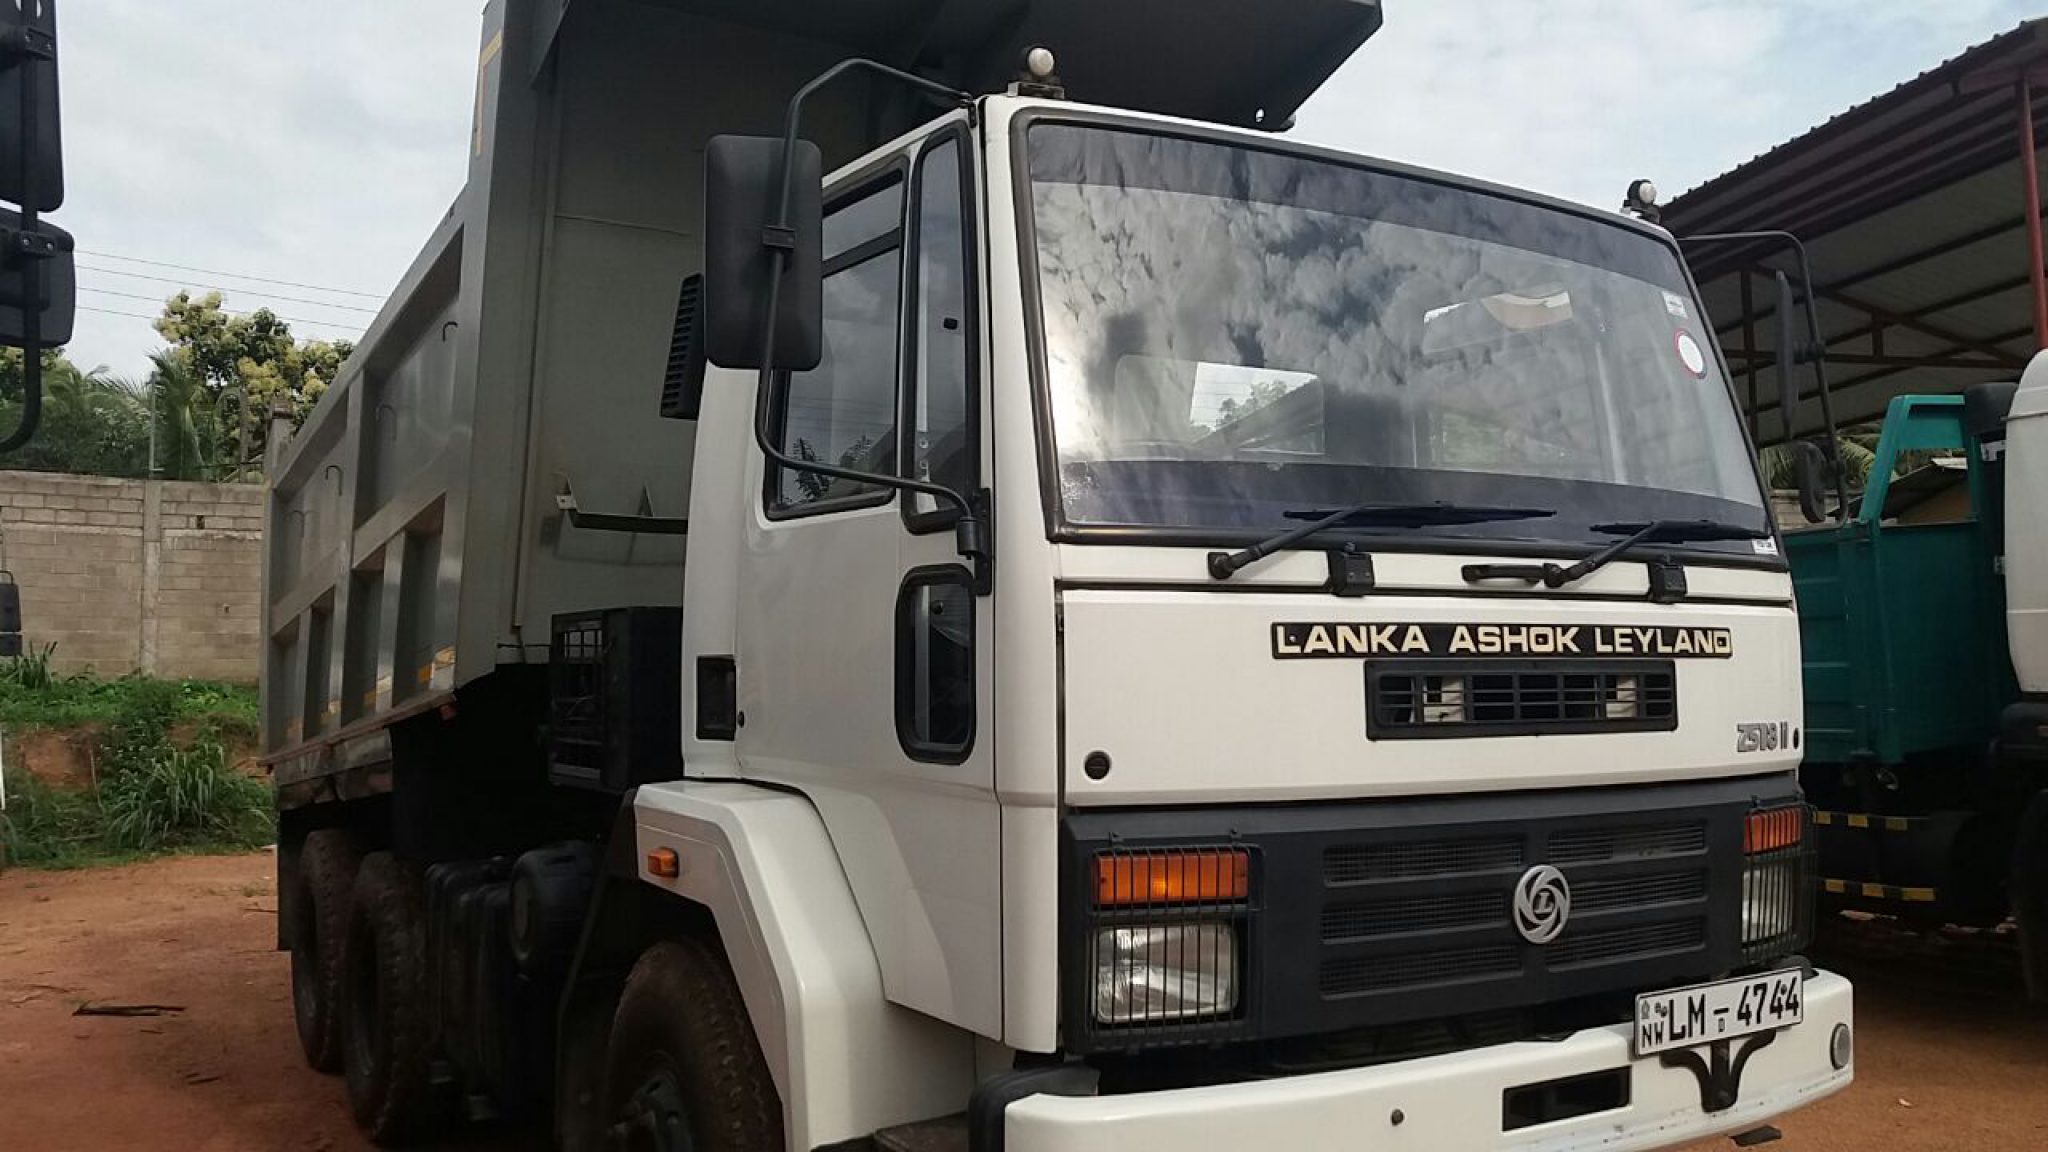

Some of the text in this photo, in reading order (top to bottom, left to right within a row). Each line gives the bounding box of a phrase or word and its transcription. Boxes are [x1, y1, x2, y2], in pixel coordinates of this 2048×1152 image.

[1276, 624, 1732, 654] LANKA ASHOK LEYLAND
[1642, 1020, 1665, 1049] NW
